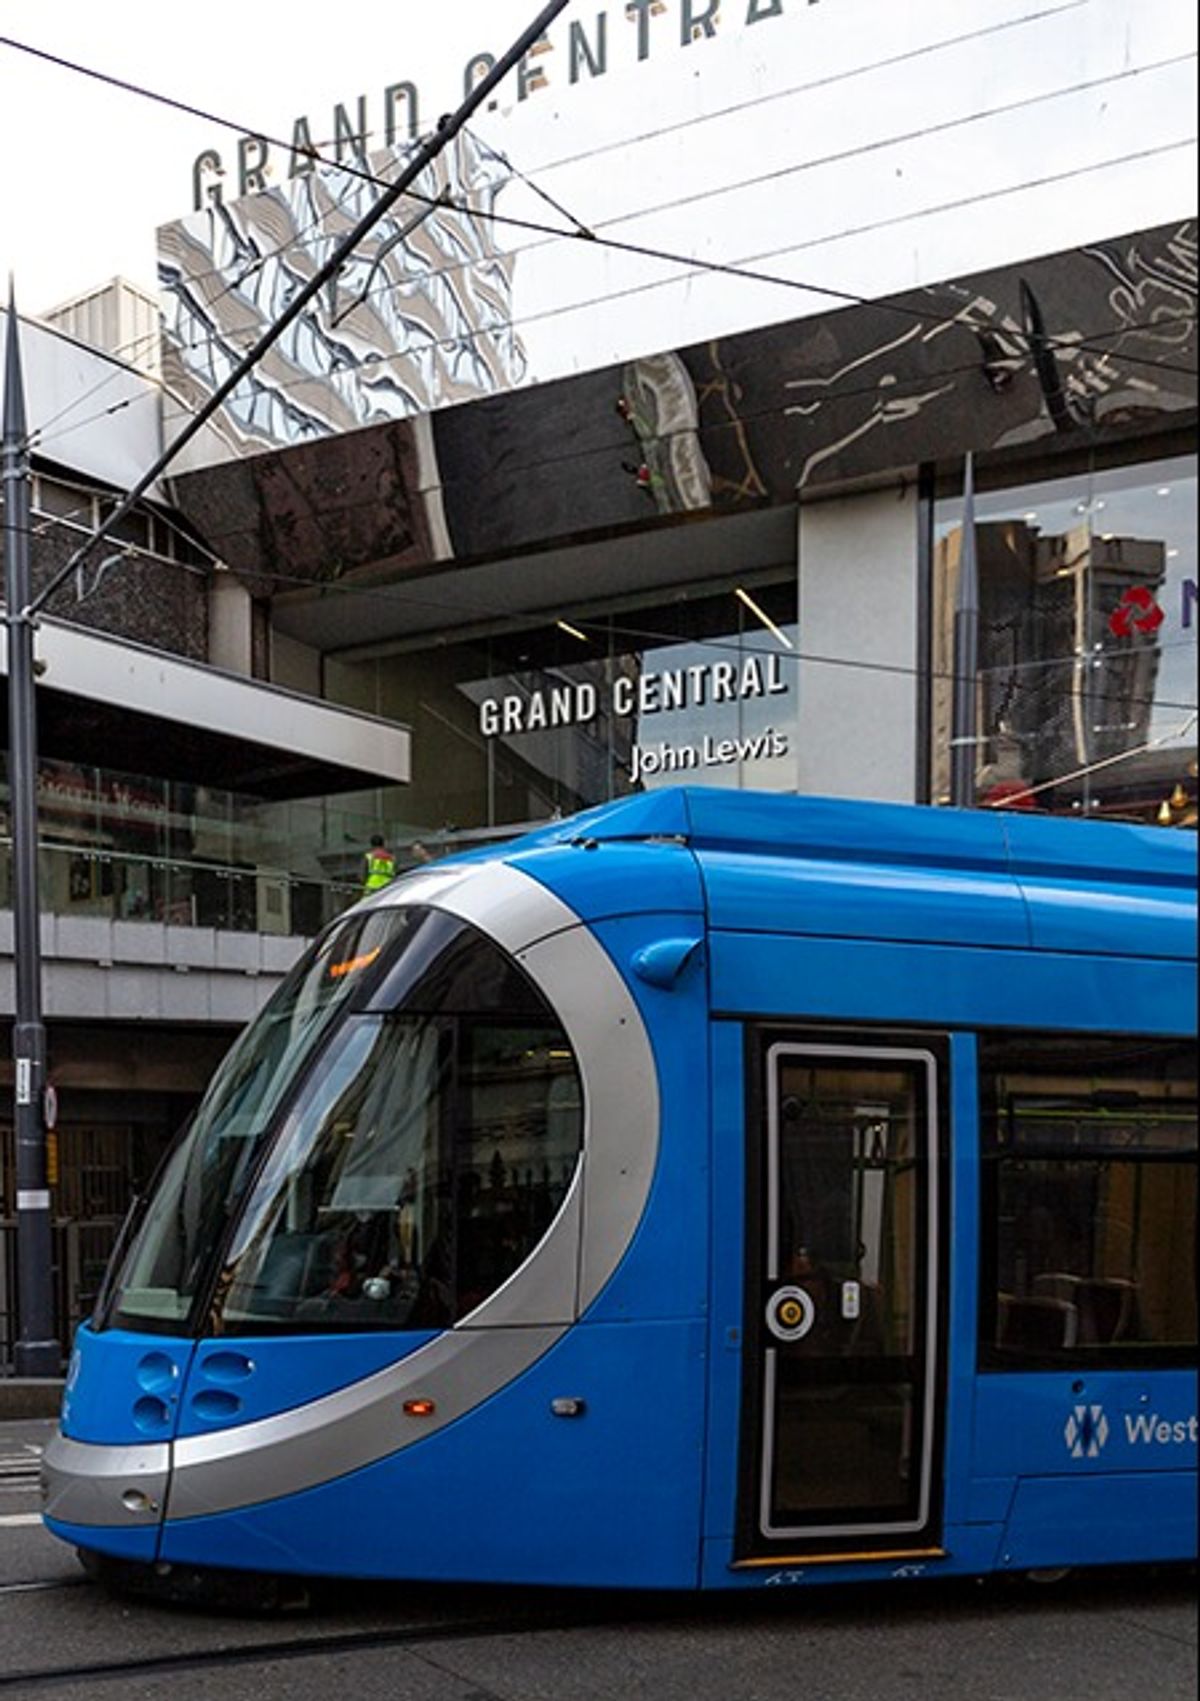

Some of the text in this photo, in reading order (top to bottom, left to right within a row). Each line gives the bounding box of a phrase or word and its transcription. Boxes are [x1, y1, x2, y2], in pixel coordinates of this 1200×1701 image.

[192, 80, 418, 212] GRAND
[480, 653, 788, 736] GRAND CENTRAL
[629, 728, 788, 783] John Lewis
[1125, 1413, 1198, 1444] West
